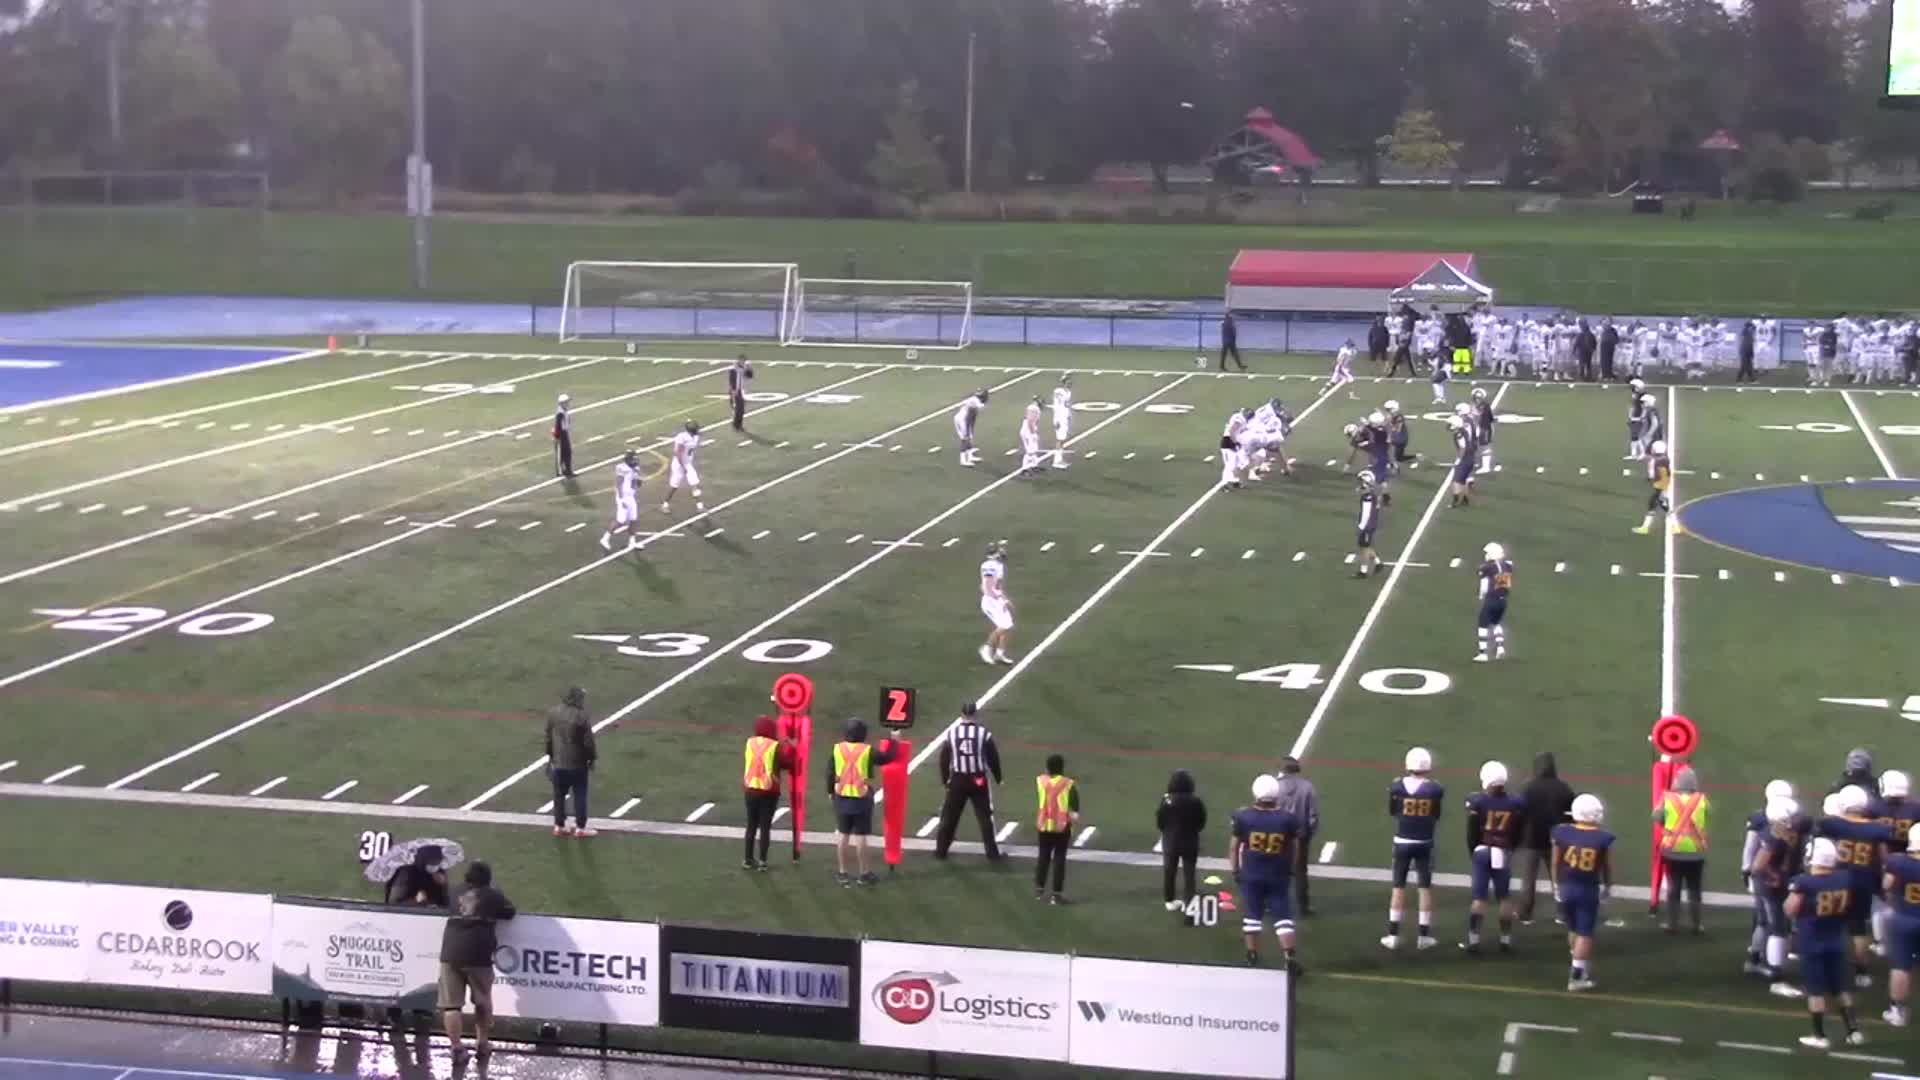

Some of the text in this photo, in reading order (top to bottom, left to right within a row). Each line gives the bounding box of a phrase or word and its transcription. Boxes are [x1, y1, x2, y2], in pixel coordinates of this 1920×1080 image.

[52, 607, 275, 635] 20
[617, 632, 833, 663] 30
[1236, 663, 1451, 695] 40
[887, 689, 908, 721] 2
[958, 739, 974, 755] 41
[1402, 798, 1433, 817] 88
[1484, 810, 1513, 831] 17
[359, 831, 390, 861] 30
[1563, 845, 1598, 872] 48
[1186, 895, 1218, 926] 40
[1816, 888, 1849, 917] 87
[22, 922, 79, 937] VALLEY
[30, 936, 80, 949] CORING
[97, 931, 261, 963] CEDARBROOK
[326, 934, 404, 963] SMUGGLERS
[345, 953, 385, 970] TRAIL
[494, 945, 648, 981] ORE-TECH
[539, 978, 625, 995] MANUFACTURING
[681, 961, 839, 1000] TITANIUM
[885, 985, 1052, 1021] C&D Logistics
[1117, 1007, 1194, 1028] Westland
[1198, 1014, 1281, 1033] Insurance
